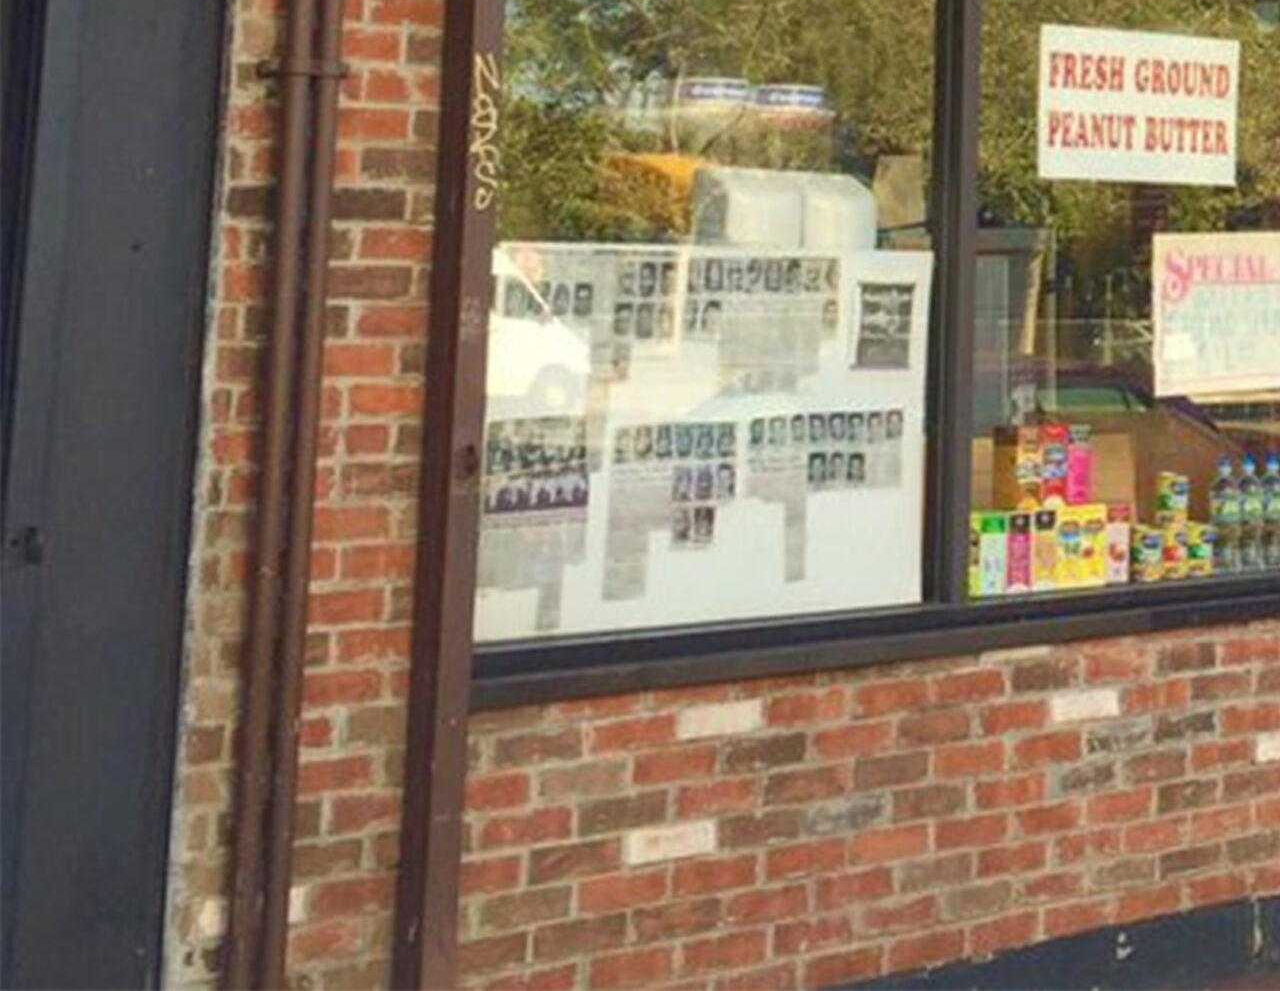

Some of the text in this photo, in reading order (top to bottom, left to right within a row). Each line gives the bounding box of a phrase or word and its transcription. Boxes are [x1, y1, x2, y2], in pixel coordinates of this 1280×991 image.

[1048, 52, 1230, 99] FRESH GROUND
[1047, 111, 1228, 155] PEANUT BUTTER
